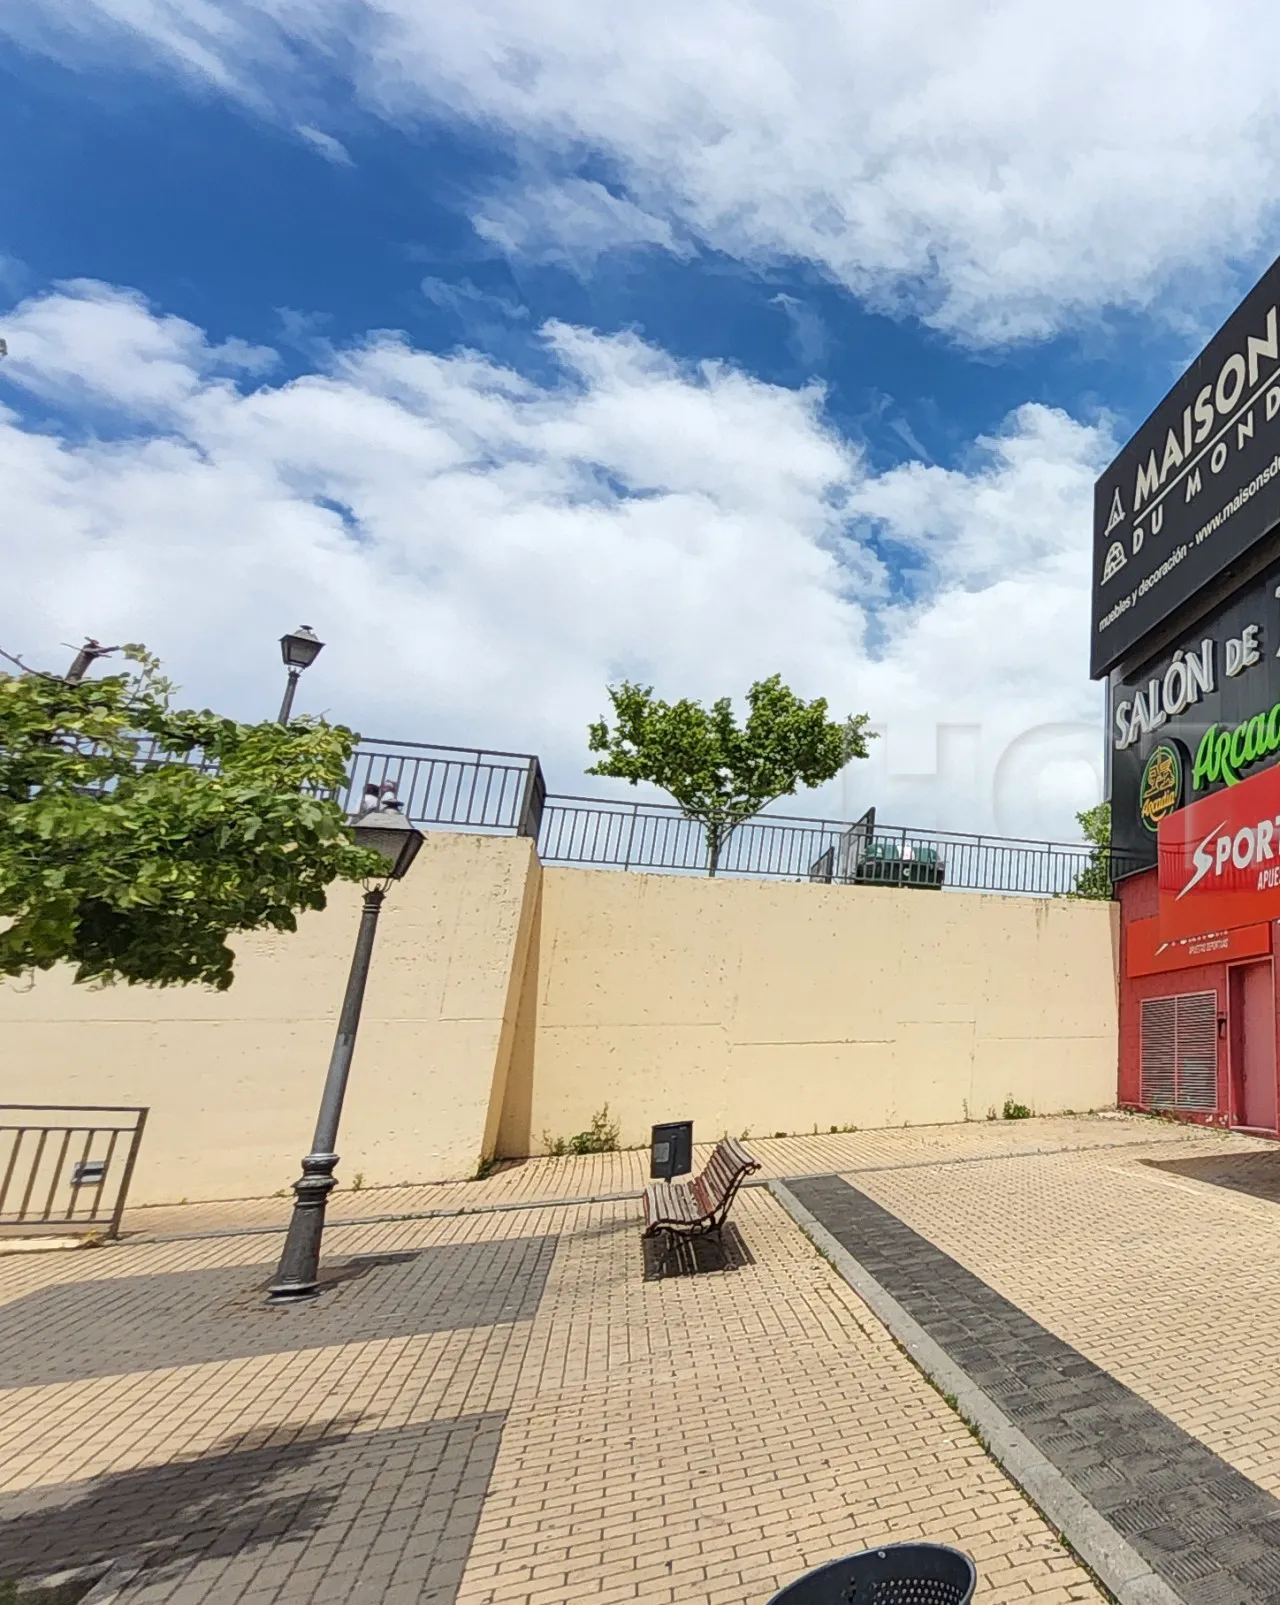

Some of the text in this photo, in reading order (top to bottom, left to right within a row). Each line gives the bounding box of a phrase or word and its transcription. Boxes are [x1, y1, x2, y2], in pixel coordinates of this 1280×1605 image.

[1132, 503, 1164, 555] DU
[1099, 596, 1131, 632] muebles
[1138, 544, 1188, 597] decoración
[1115, 638, 1216, 750] SALÓN
[1226, 624, 1260, 678] DE
